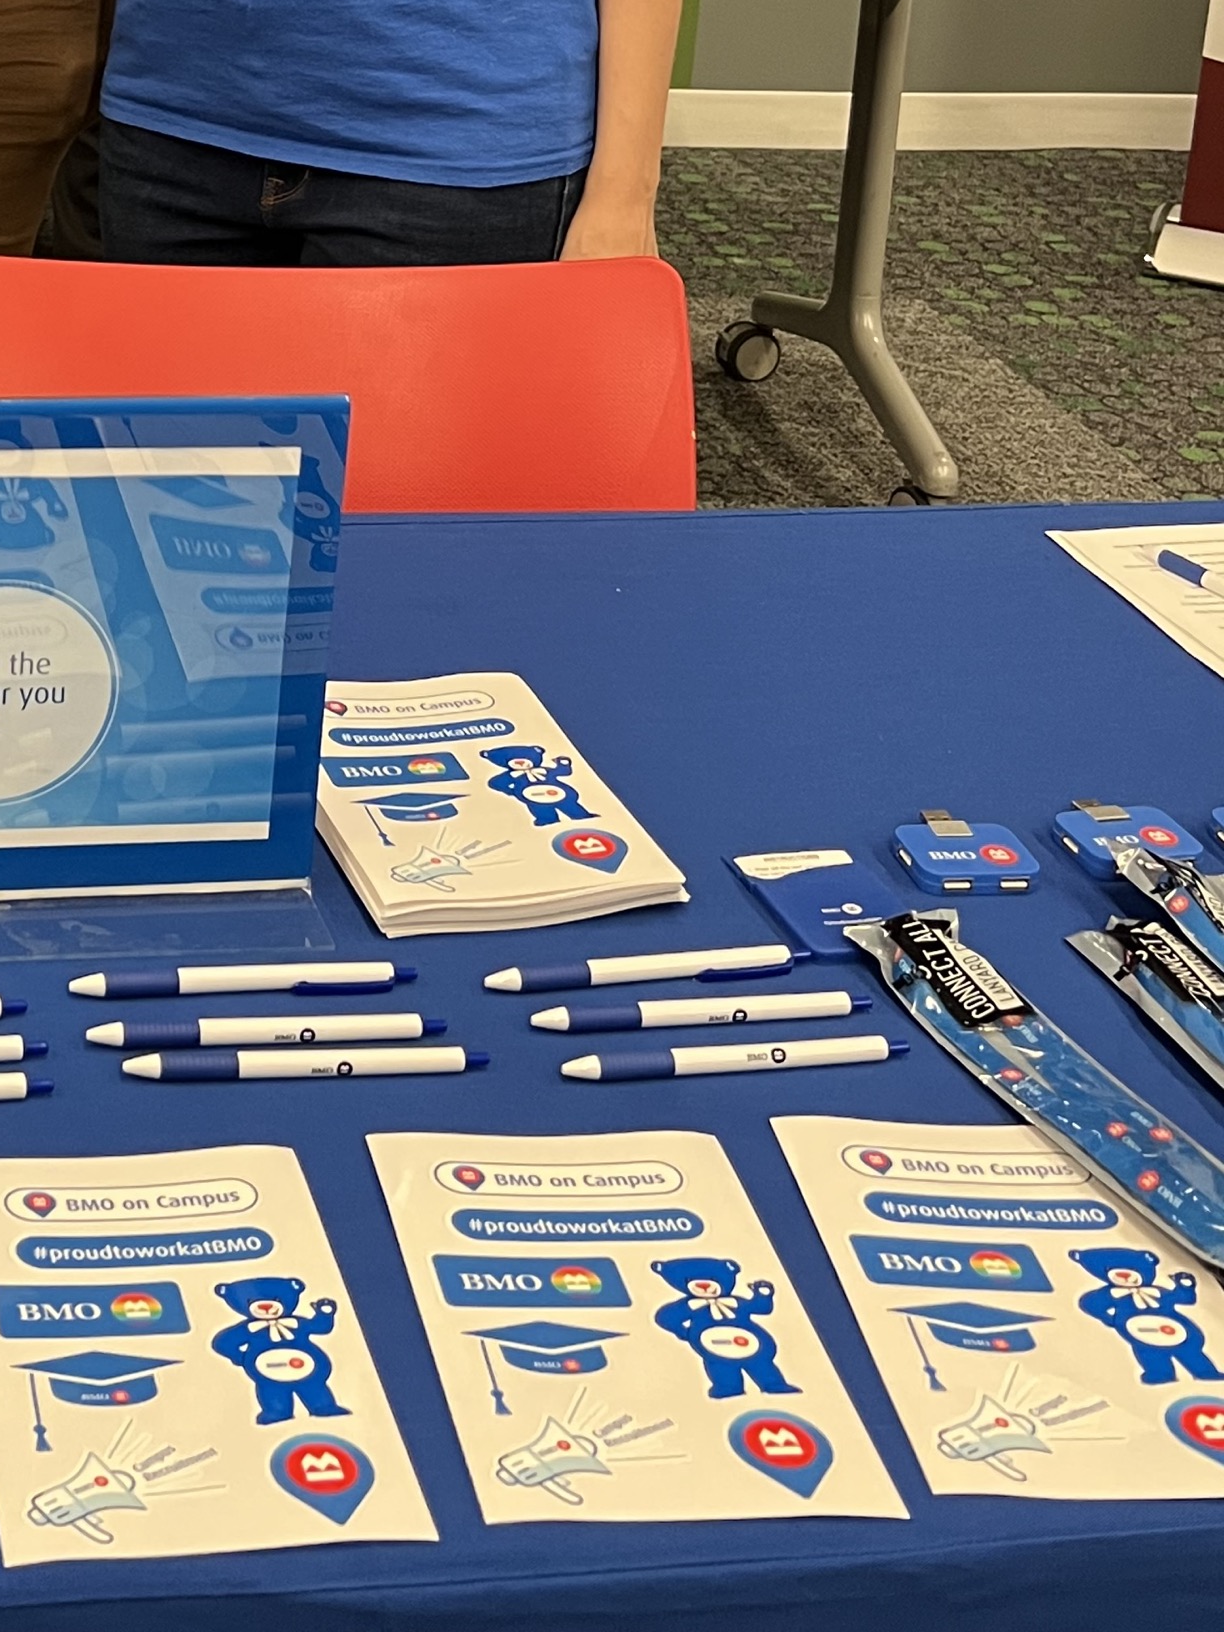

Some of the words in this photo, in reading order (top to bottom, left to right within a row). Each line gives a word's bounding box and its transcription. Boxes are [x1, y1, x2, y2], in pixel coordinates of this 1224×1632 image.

[9, 651, 52, 676] the
[18, 685, 66, 712] you
[354, 705, 391, 715] BMO
[395, 704, 416, 713] on
[419, 696, 482, 712] Campus
[341, 722, 507, 745] #proudtoworkatBMO
[341, 764, 403, 778] BMO
[928, 850, 977, 862] BMO
[923, 949, 996, 1019] CONNECT
[962, 954, 1015, 1003] LANYARD
[900, 1158, 950, 1174] BMO
[957, 1162, 985, 1176] on
[989, 1162, 1075, 1180] Campus
[493, 1173, 543, 1187] BMO
[549, 1175, 577, 1187] on
[582, 1172, 666, 1189] Campus
[65, 1198, 115, 1212] BMO
[122, 1198, 150, 1211] on
[156, 1189, 241, 1209] Campus
[881, 1200, 1106, 1223] #proudtoworkatBMO
[468, 1217, 693, 1236] #proudtoworkatBMO
[33, 1236, 262, 1263] #proudtoworkatBMO
[877, 1252, 962, 1274] BMO
[458, 1272, 543, 1292] BMO
[16, 1302, 102, 1321] BMO
